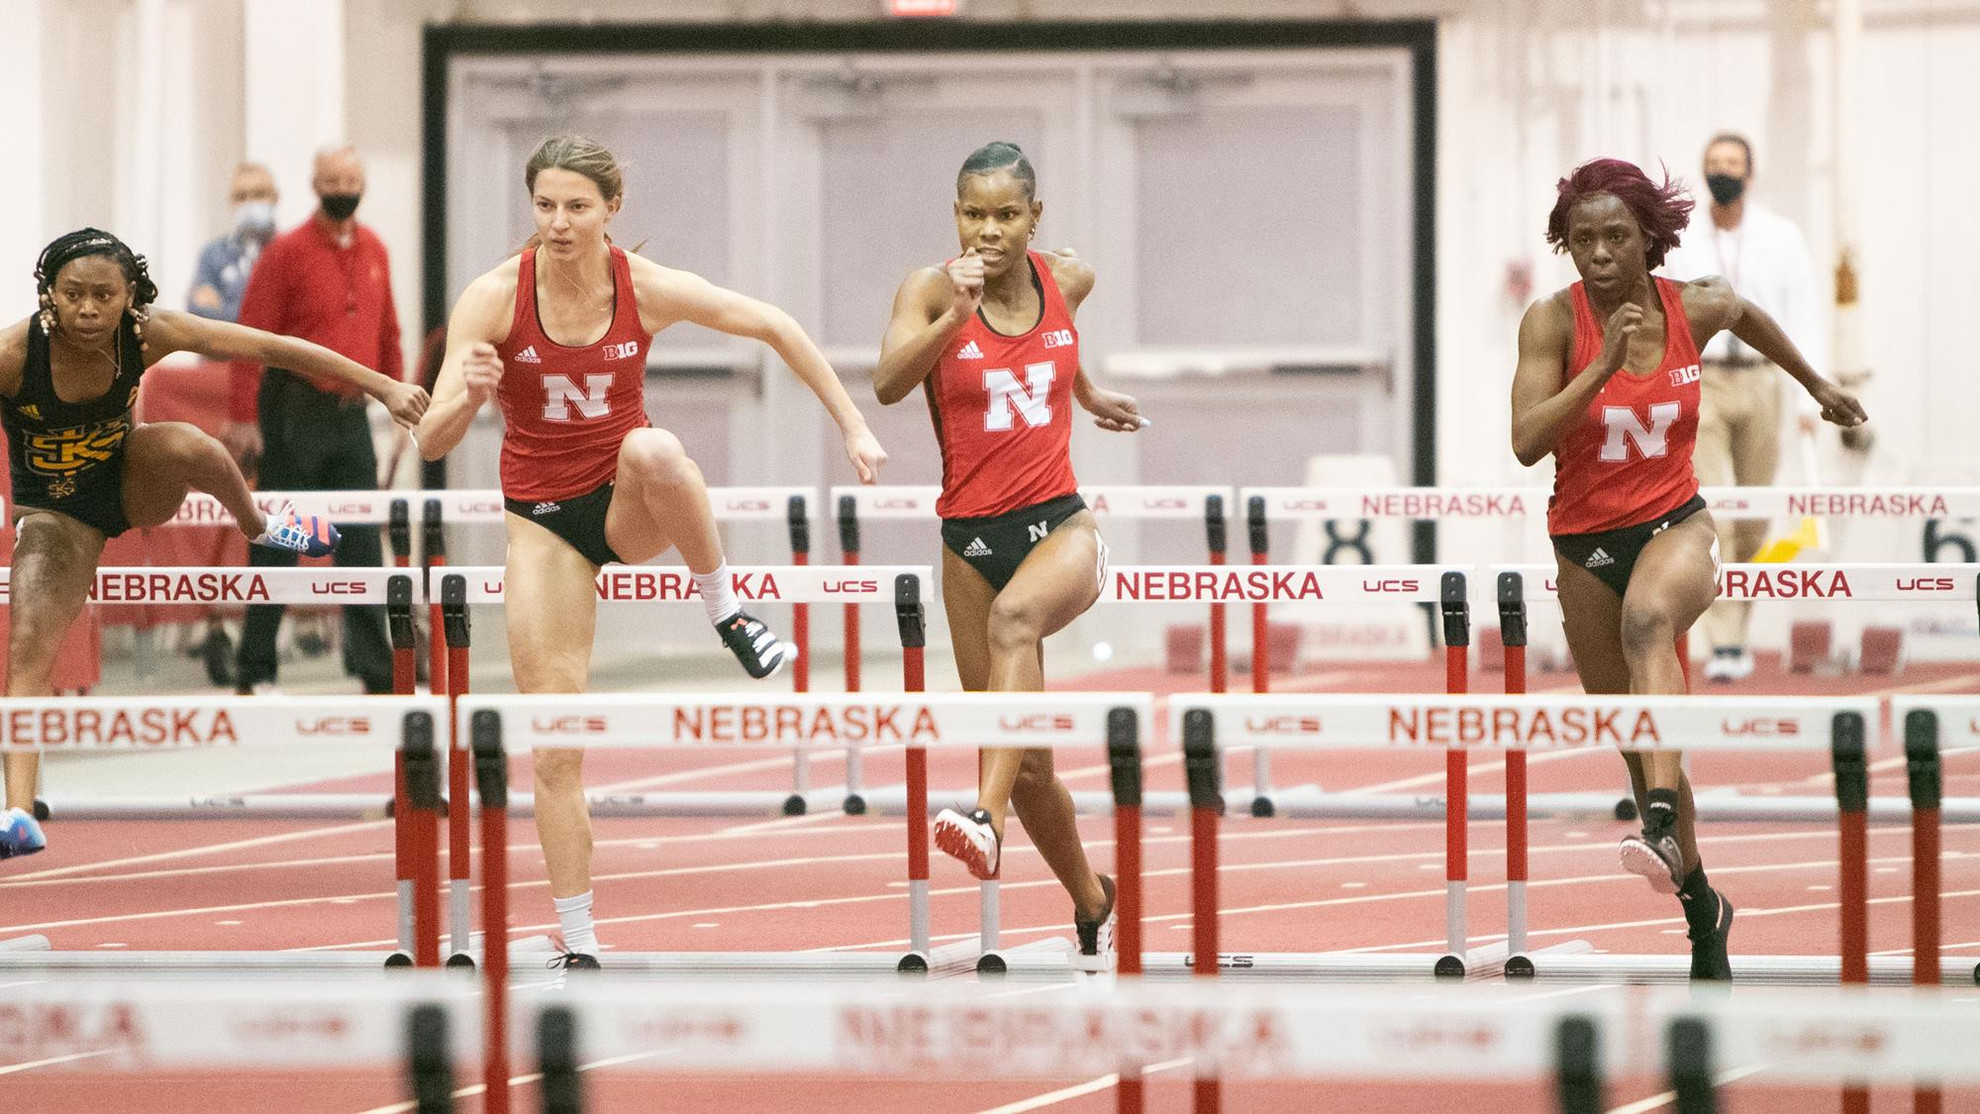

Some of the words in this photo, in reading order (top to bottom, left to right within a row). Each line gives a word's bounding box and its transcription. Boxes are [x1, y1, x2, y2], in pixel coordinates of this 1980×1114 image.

[541, 371, 616, 422] N
[982, 360, 1056, 432] N
[1598, 400, 1682, 463] N
[328, 503, 372, 515] UCS
[532, 504, 561, 515] adidas
[727, 499, 770, 511] UCS
[874, 498, 918, 510] UCS
[1144, 498, 1188, 509] UCS
[1284, 499, 1327, 511] UCS
[1362, 494, 1527, 517] NEBRASKA
[1787, 493, 1949, 516] NEBRASKA
[1028, 520, 1049, 543] N
[963, 547, 993, 557] adidas
[1585, 556, 1616, 568] adidas
[312, 581, 367, 594] UCS
[823, 580, 878, 593] UCS
[1116, 571, 1324, 600] NEBRASKA
[1363, 579, 1419, 592] UCS
[1896, 577, 1954, 591] UCS
[0, 708, 238, 745] EBRASKA
[296, 717, 372, 735] UCS
[531, 716, 608, 734] UCS
[672, 705, 940, 741] NEBRASKA
[999, 714, 1075, 732] UCS
[1245, 715, 1322, 733] UCS
[1388, 706, 1661, 743] NEBRASKA
[1722, 717, 1799, 736] UCS
